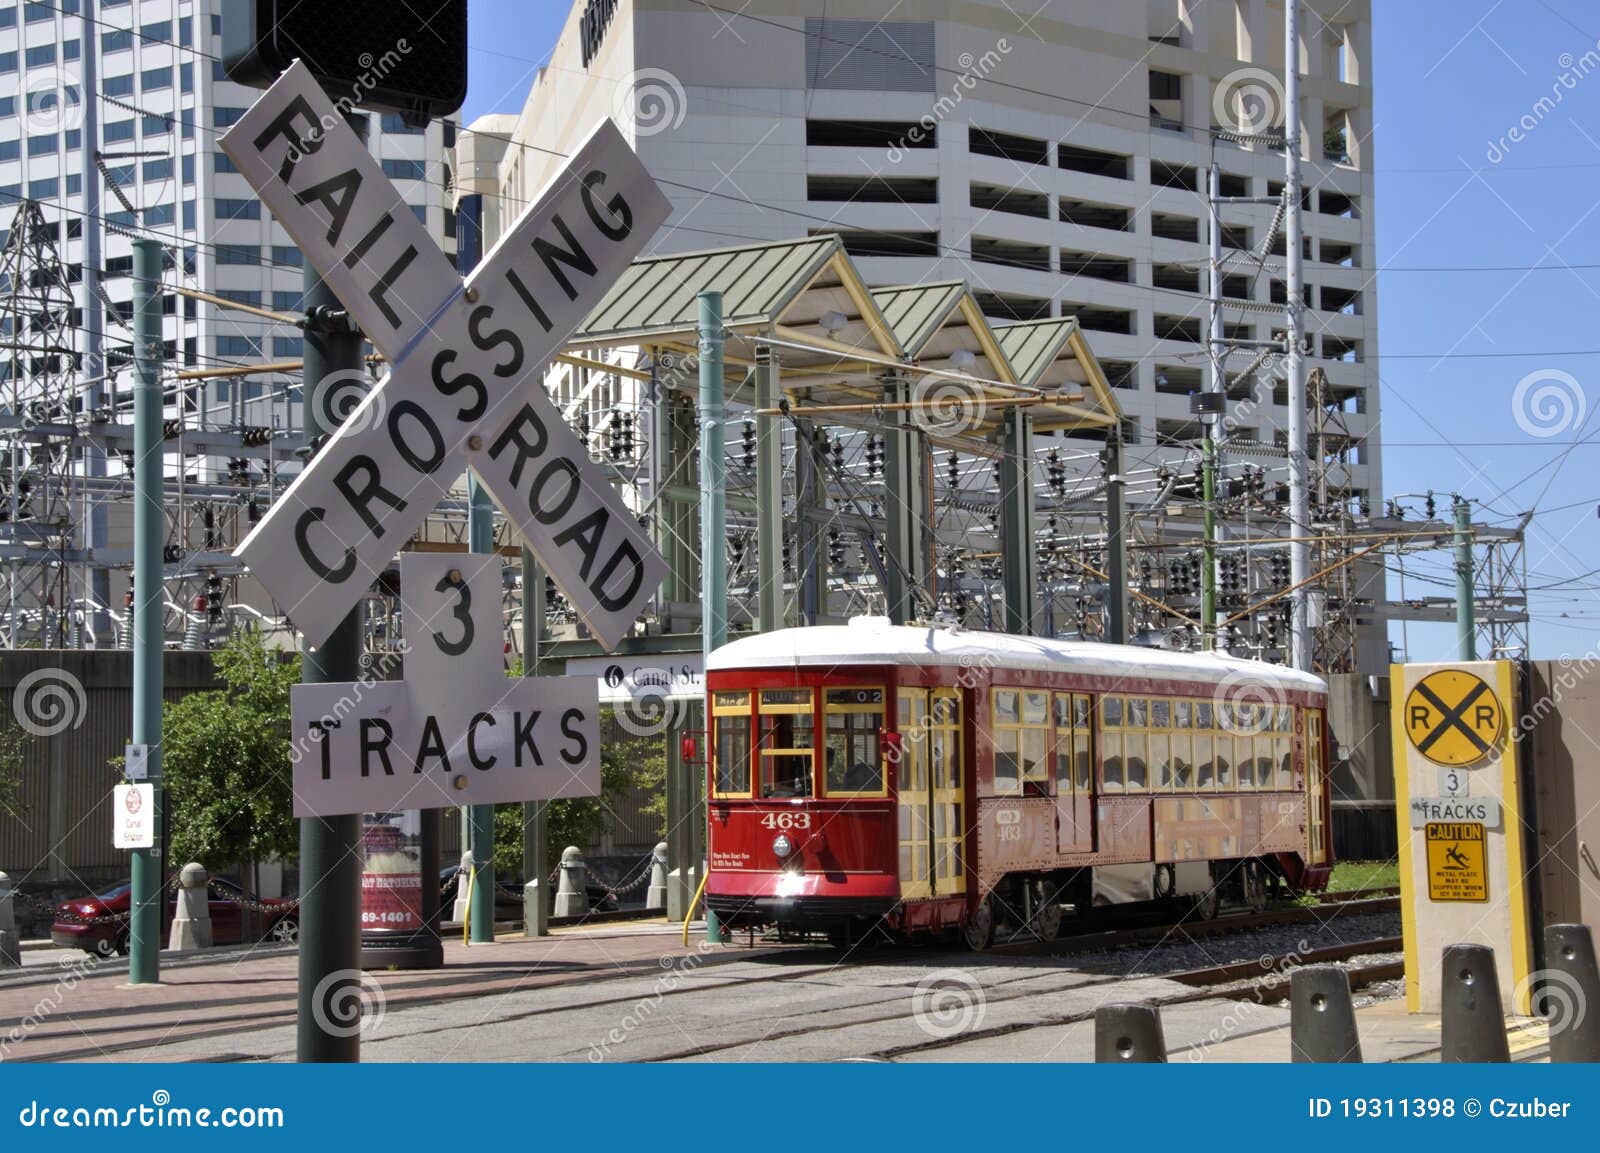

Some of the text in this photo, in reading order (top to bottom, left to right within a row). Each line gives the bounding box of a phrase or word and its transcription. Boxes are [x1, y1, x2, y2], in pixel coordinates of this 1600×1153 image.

[253, 94, 646, 610] RAIL ROAD
[294, 167, 634, 585] CROSSING
[432, 574, 475, 656] 3
[632, 666, 675, 687] Canal
[682, 665, 700, 685] St.
[308, 708, 588, 780] TRACKS
[1447, 773, 1459, 792] 3
[760, 812, 812, 830] 463
[1422, 804, 1487, 820] TRACKS
[1428, 824, 1482, 839] CAUTION
